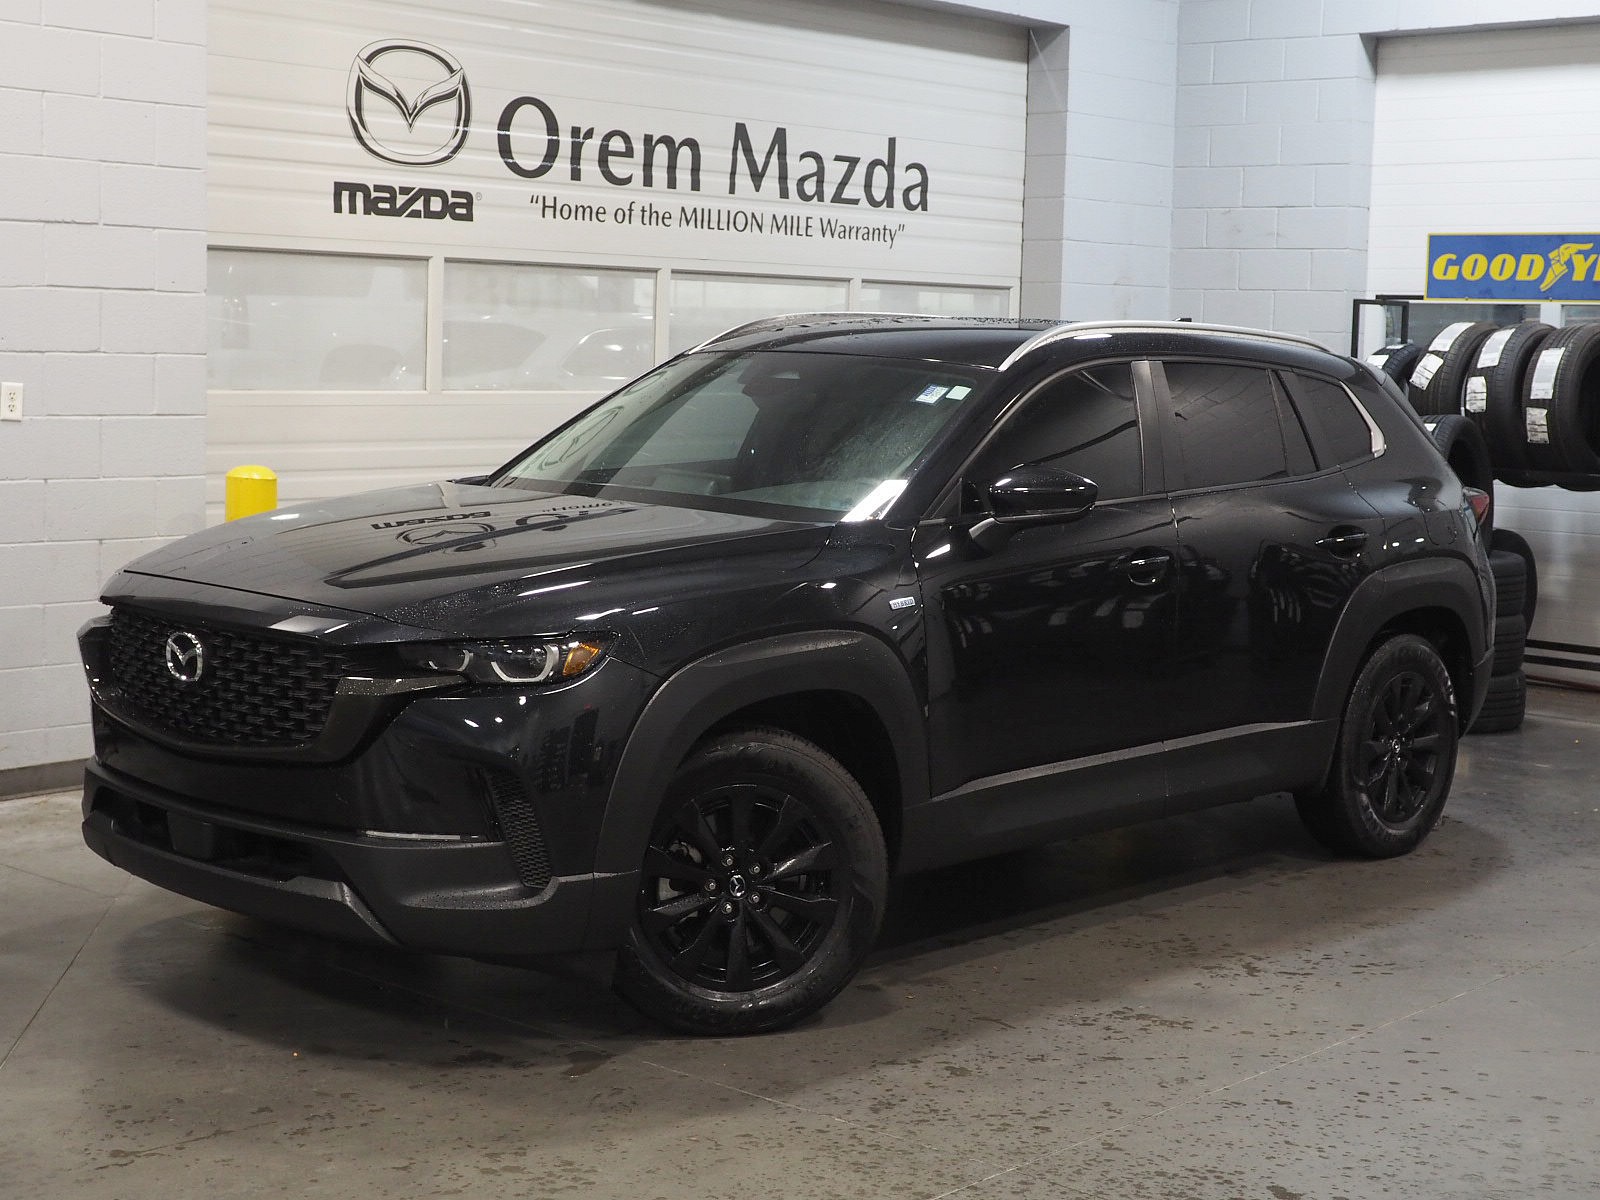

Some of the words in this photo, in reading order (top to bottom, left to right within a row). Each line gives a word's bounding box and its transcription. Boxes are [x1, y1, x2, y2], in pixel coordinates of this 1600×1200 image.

[496, 96, 702, 192] Orem
[728, 122, 930, 212] Mazda
[613, 200, 636, 224] of
[640, 202, 672, 228] the
[678, 206, 764, 234] MILLION
[770, 213, 813, 238] MILE
[1432, 253, 1600, 281] GOODY
